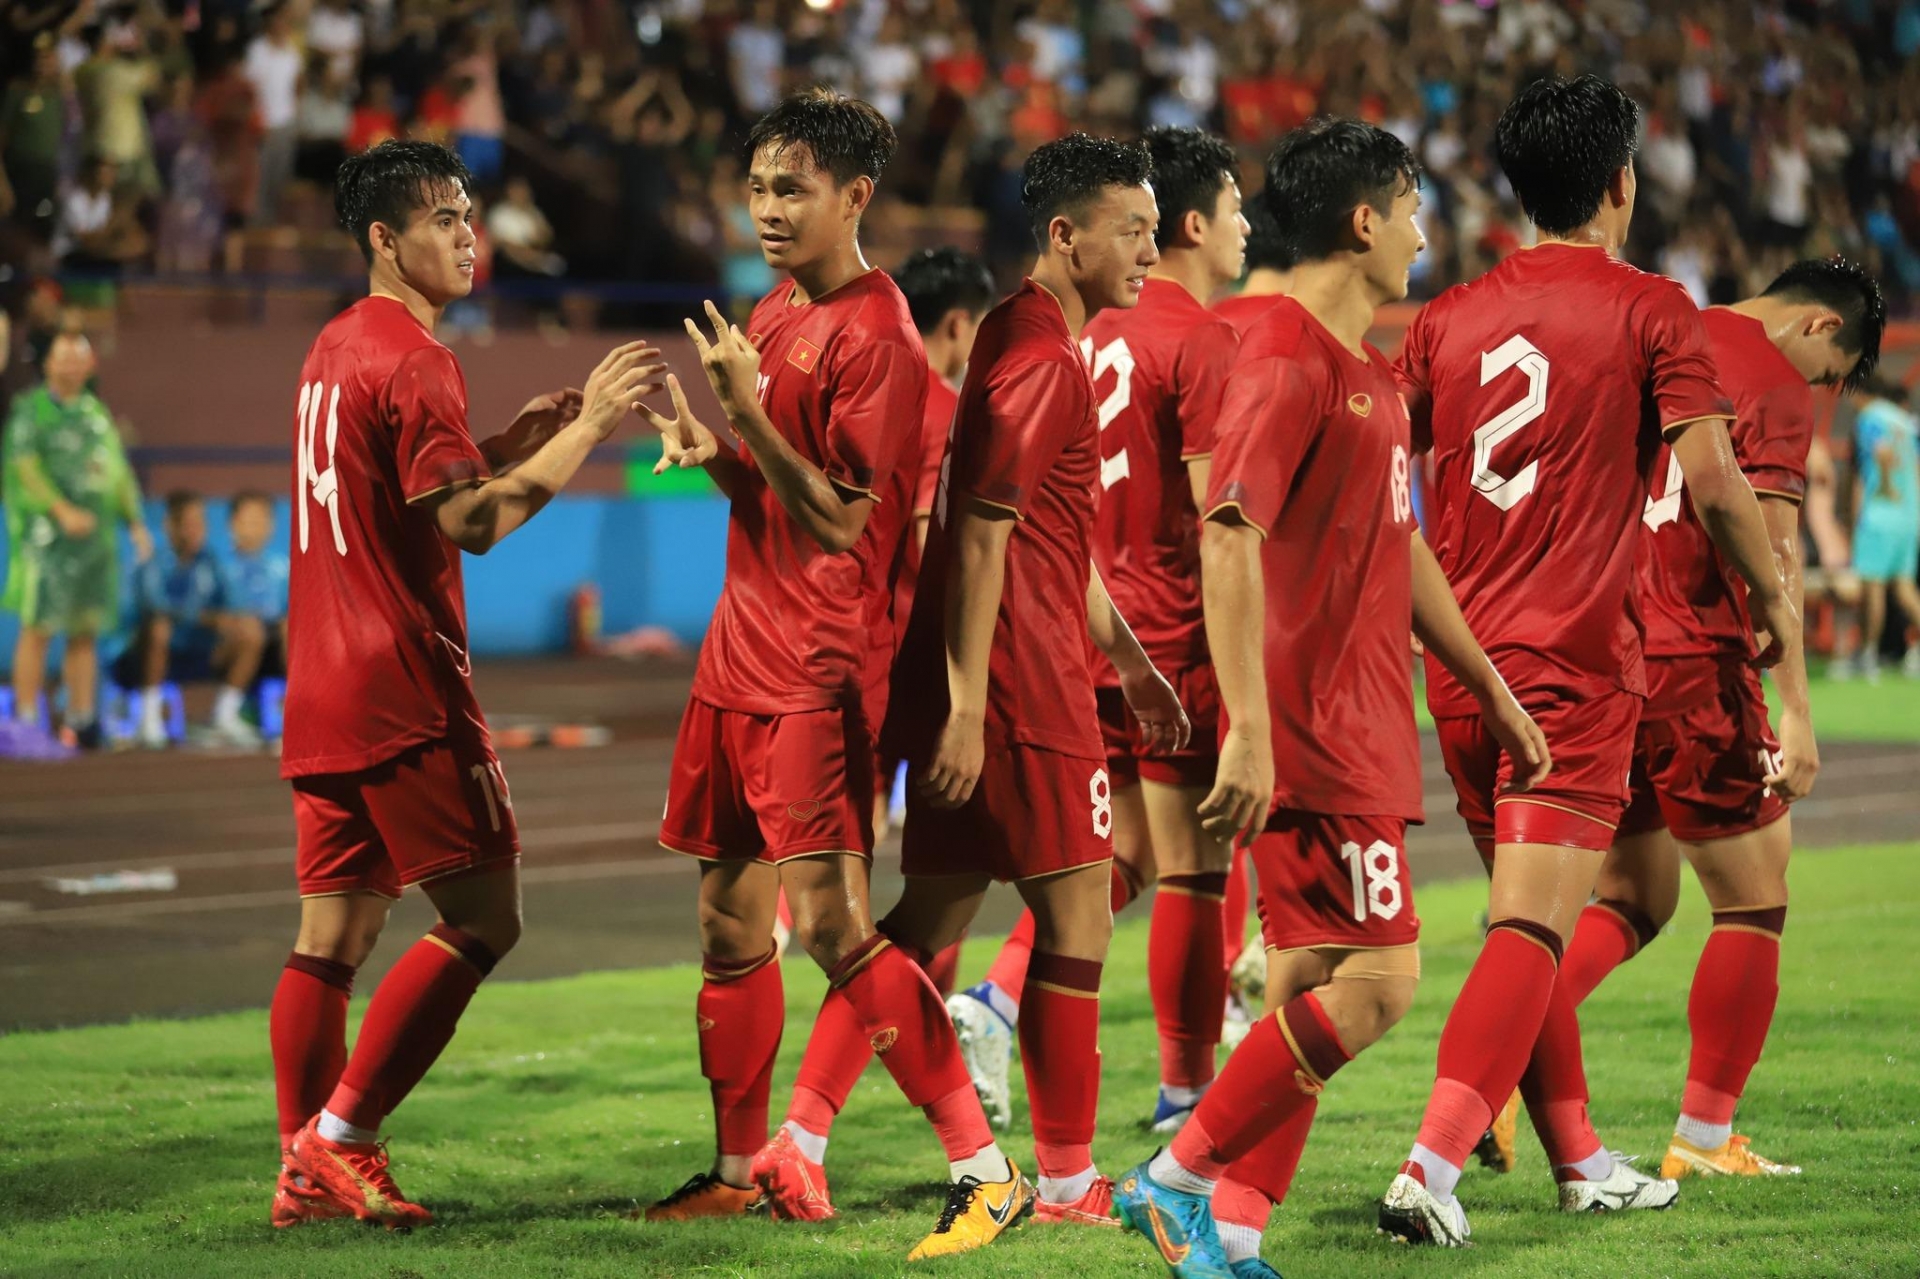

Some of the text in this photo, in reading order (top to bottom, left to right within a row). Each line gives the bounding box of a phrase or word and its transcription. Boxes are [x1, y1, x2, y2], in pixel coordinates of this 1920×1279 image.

[1470, 333, 1550, 512] 2
[297, 380, 348, 557] 14
[1390, 444, 1411, 524] 18
[1089, 767, 1112, 840] 8
[1341, 839, 1403, 923] 18
